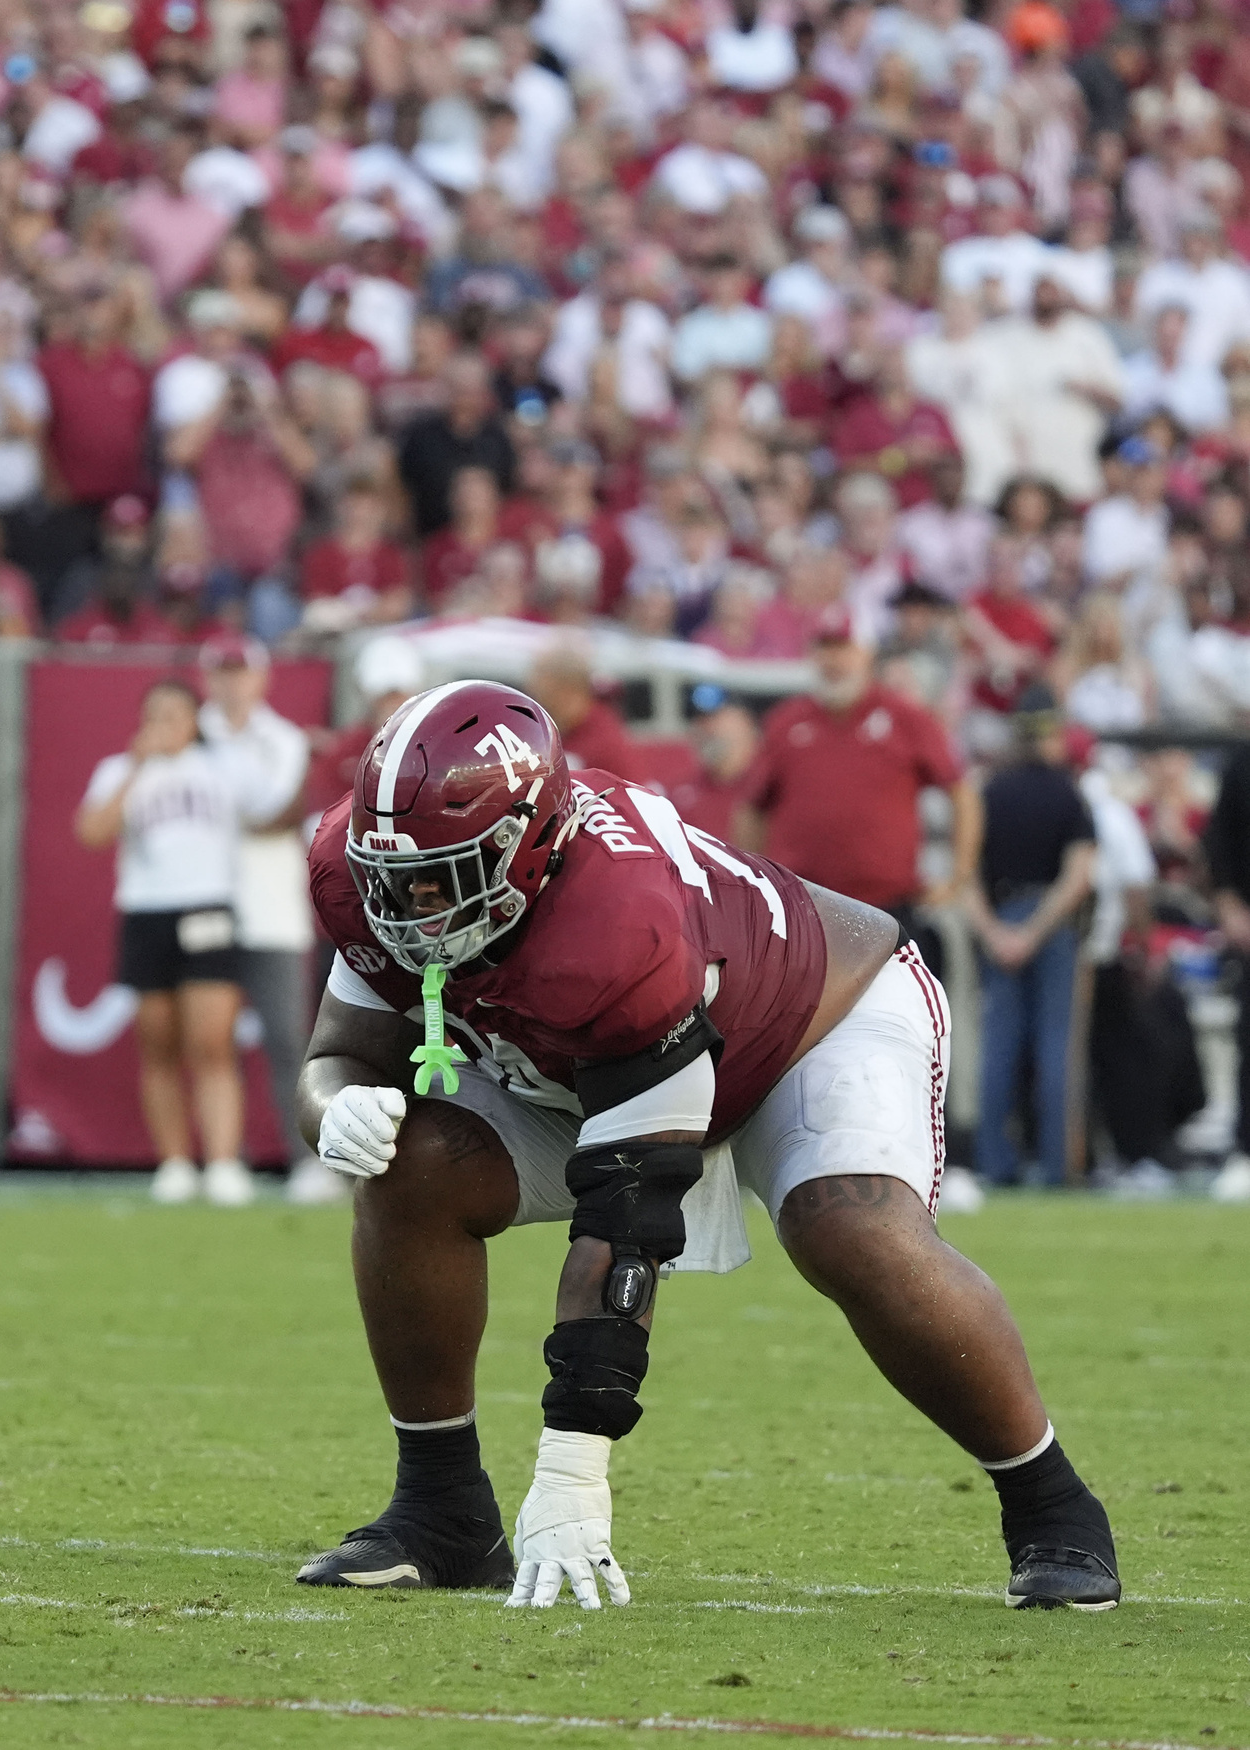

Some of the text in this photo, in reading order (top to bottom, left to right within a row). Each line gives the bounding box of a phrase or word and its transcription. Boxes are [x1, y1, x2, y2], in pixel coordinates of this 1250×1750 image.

[474, 724, 540, 793] 74
[346, 943, 387, 973] SEC
[425, 1000, 441, 1040] NXTRND
[666, 1261, 677, 1270] 74
[622, 1268, 634, 1308] DONJOY
